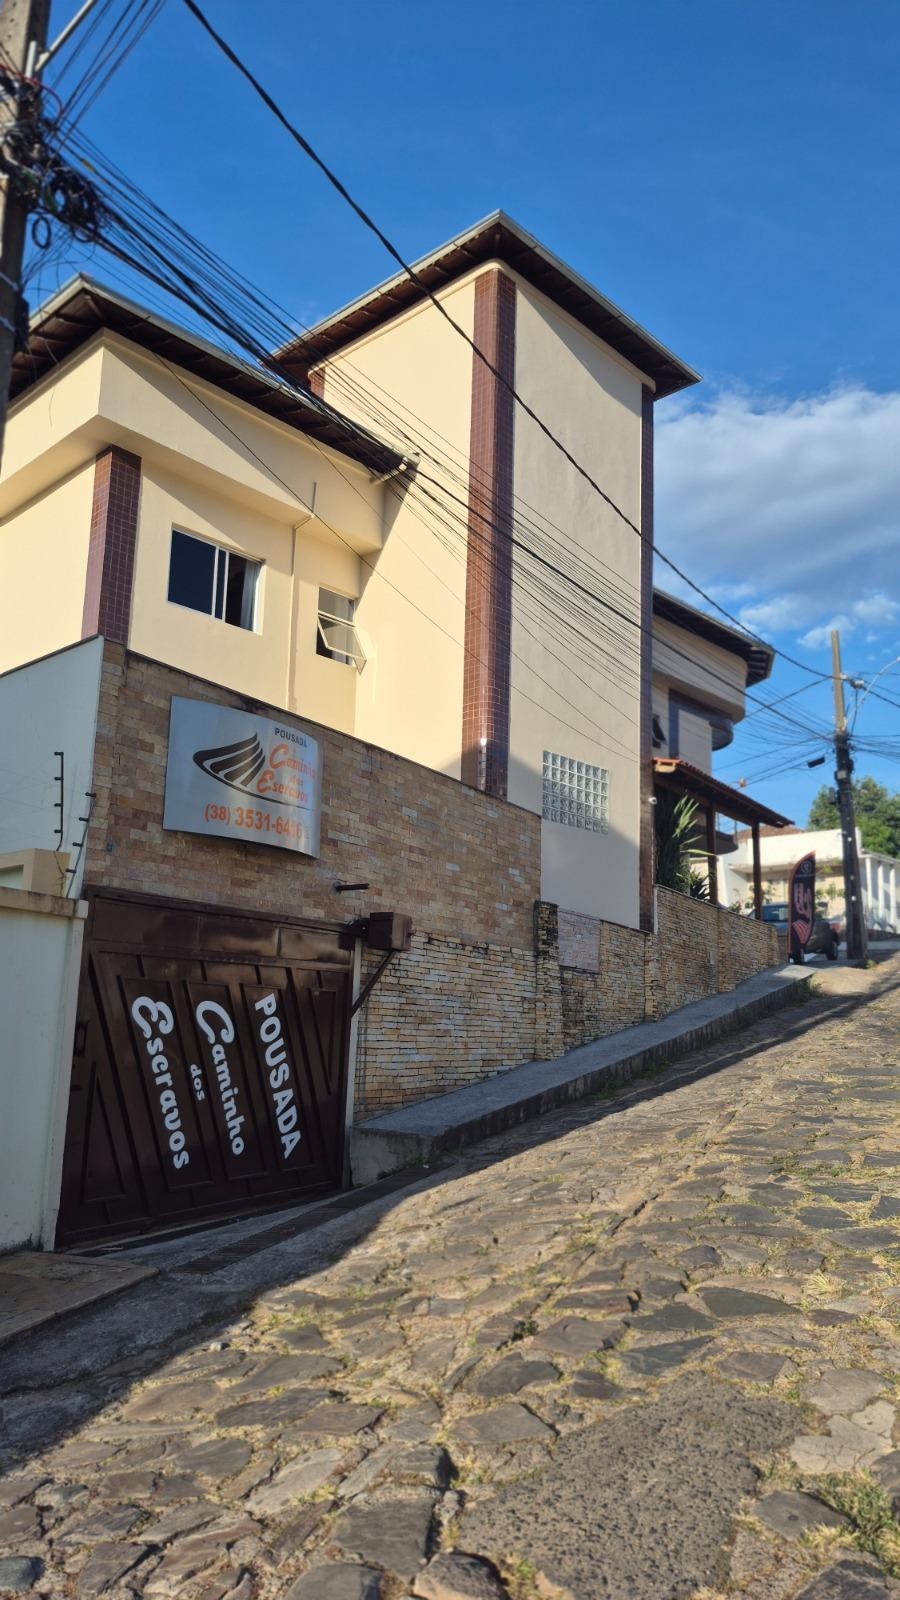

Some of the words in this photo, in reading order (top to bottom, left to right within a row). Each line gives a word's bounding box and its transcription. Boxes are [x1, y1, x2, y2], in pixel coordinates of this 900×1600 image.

[274, 727, 308, 748] POUSADA
[204, 803, 231, 826] (38)
[131, 995, 190, 1170] Escravos
[190, 1063, 206, 1101] dos
[195, 1000, 245, 1156] Caminho
[254, 992, 302, 1160] POUSADA
